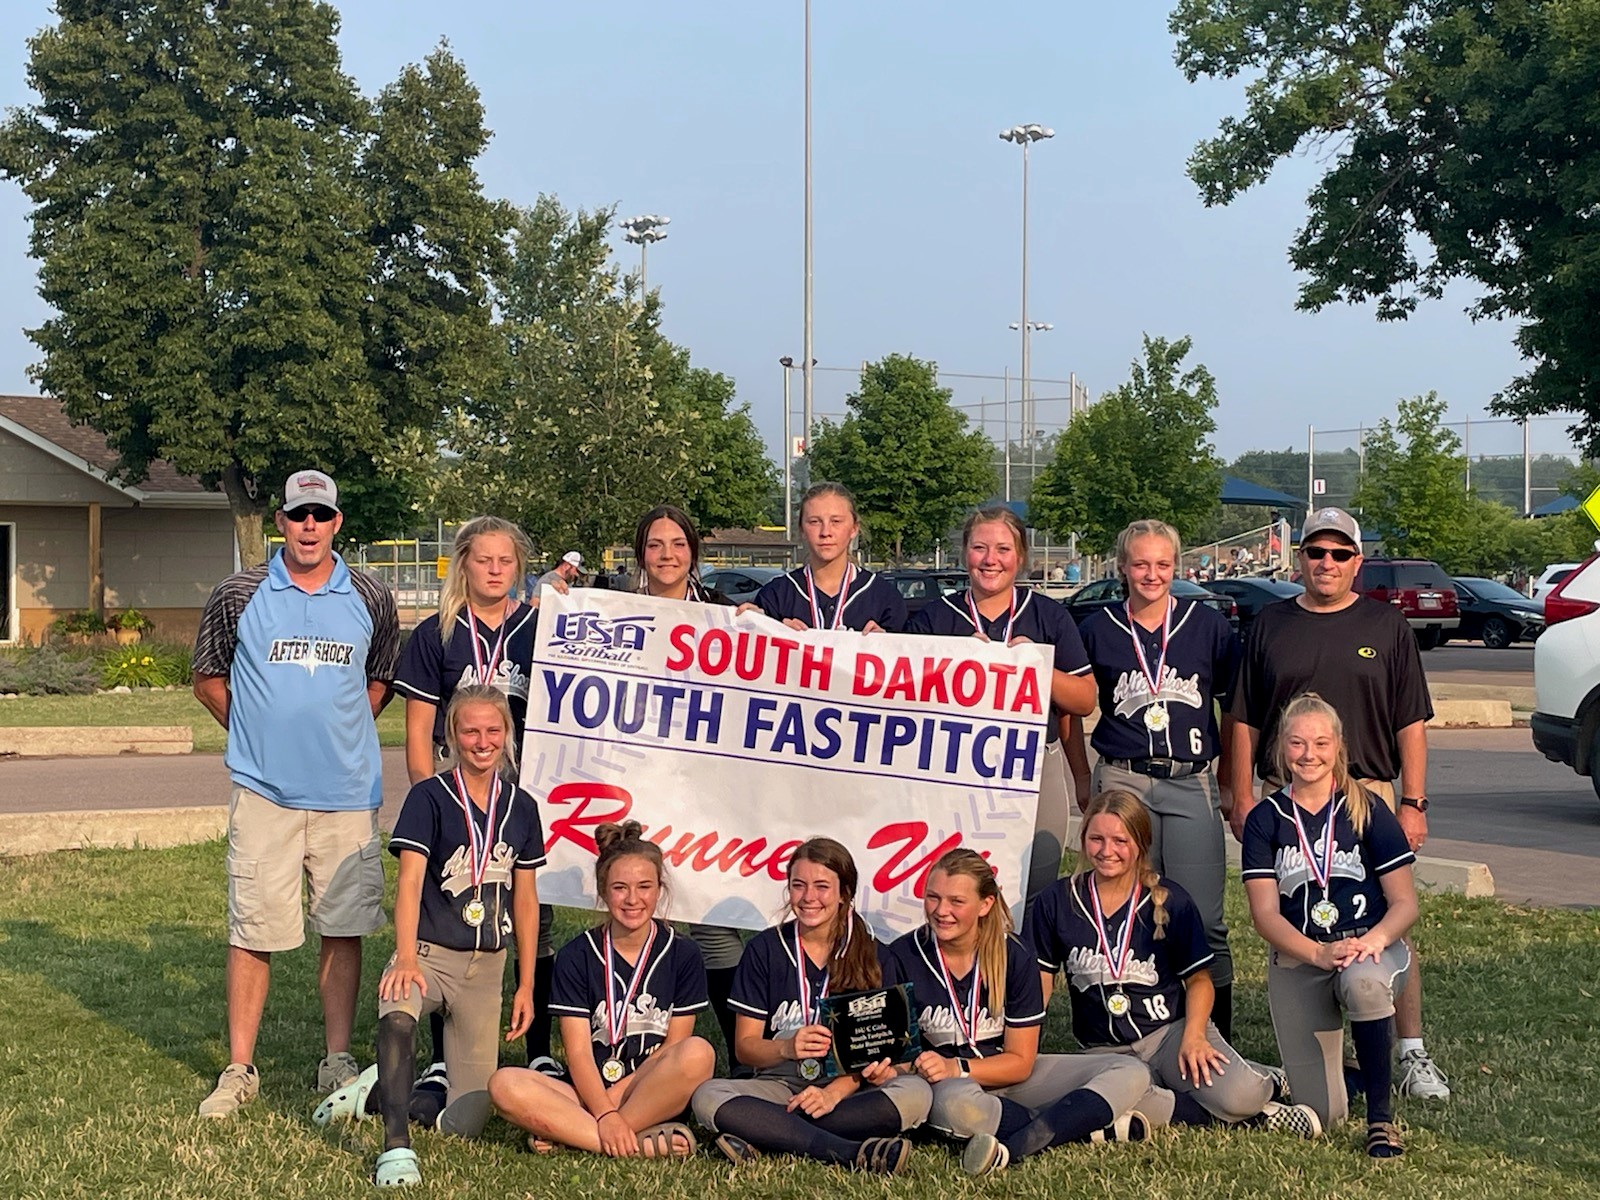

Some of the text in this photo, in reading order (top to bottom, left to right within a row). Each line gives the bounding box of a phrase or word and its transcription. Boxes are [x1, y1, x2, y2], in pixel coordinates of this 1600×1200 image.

[553, 612, 648, 651] USA
[269, 641, 354, 665] AFTER SHOCK
[560, 643, 633, 663] Softball
[499, 660, 531, 688] Sho
[665, 624, 1043, 715] SOUTH DAKOTA
[1113, 669, 1150, 703] Afte
[541, 669, 1040, 782] YOUTH FASTPITCH
[1189, 727, 1202, 755] 6
[543, 782, 999, 899] Rnne U
[1274, 845, 1309, 880] Afte
[1352, 893, 1368, 920] 2
[918, 1005, 956, 1034] Afte
[1142, 994, 1171, 1021] 18
